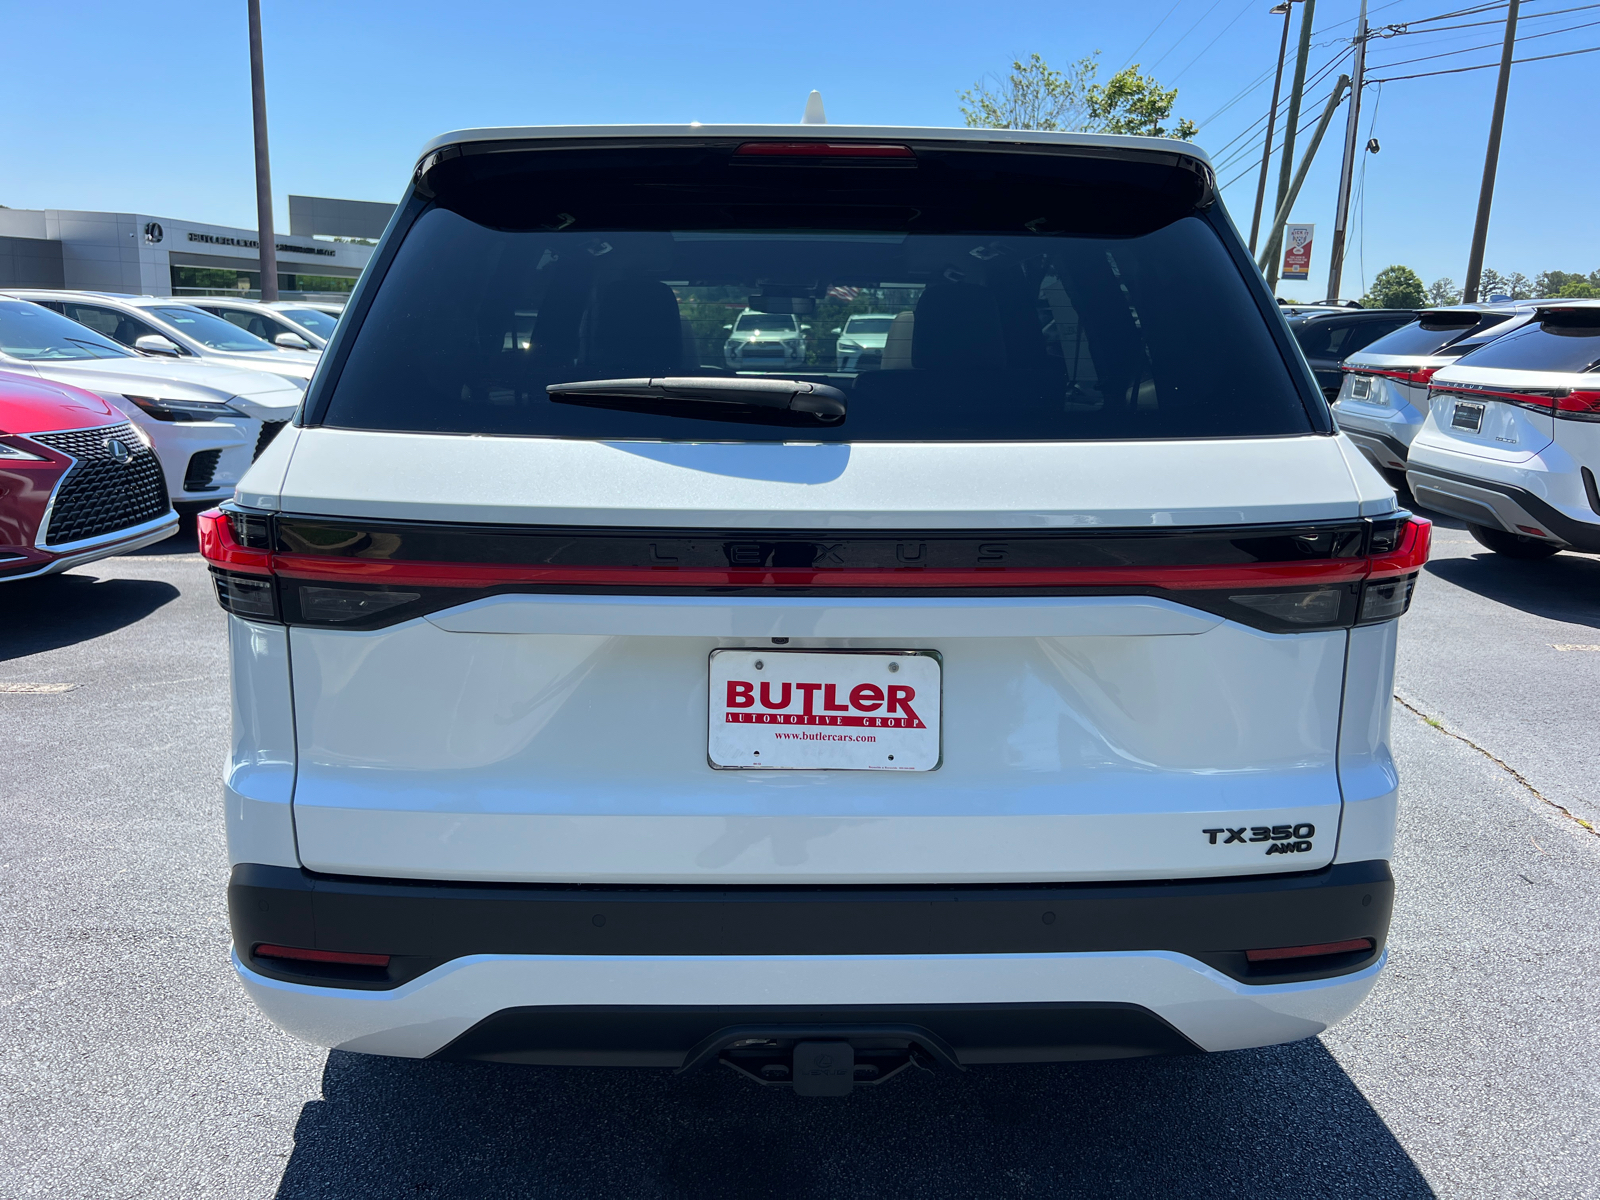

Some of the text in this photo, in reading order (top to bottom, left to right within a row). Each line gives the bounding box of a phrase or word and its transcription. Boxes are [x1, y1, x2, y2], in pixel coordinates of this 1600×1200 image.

[649, 543, 1010, 564] LEXUS
[727, 713, 920, 728] AUTOMOTIVE GROUP
[775, 732, 877, 743] www.butlercars.com
[1202, 823, 1316, 845] TX350
[1265, 840, 1313, 855] AWD
